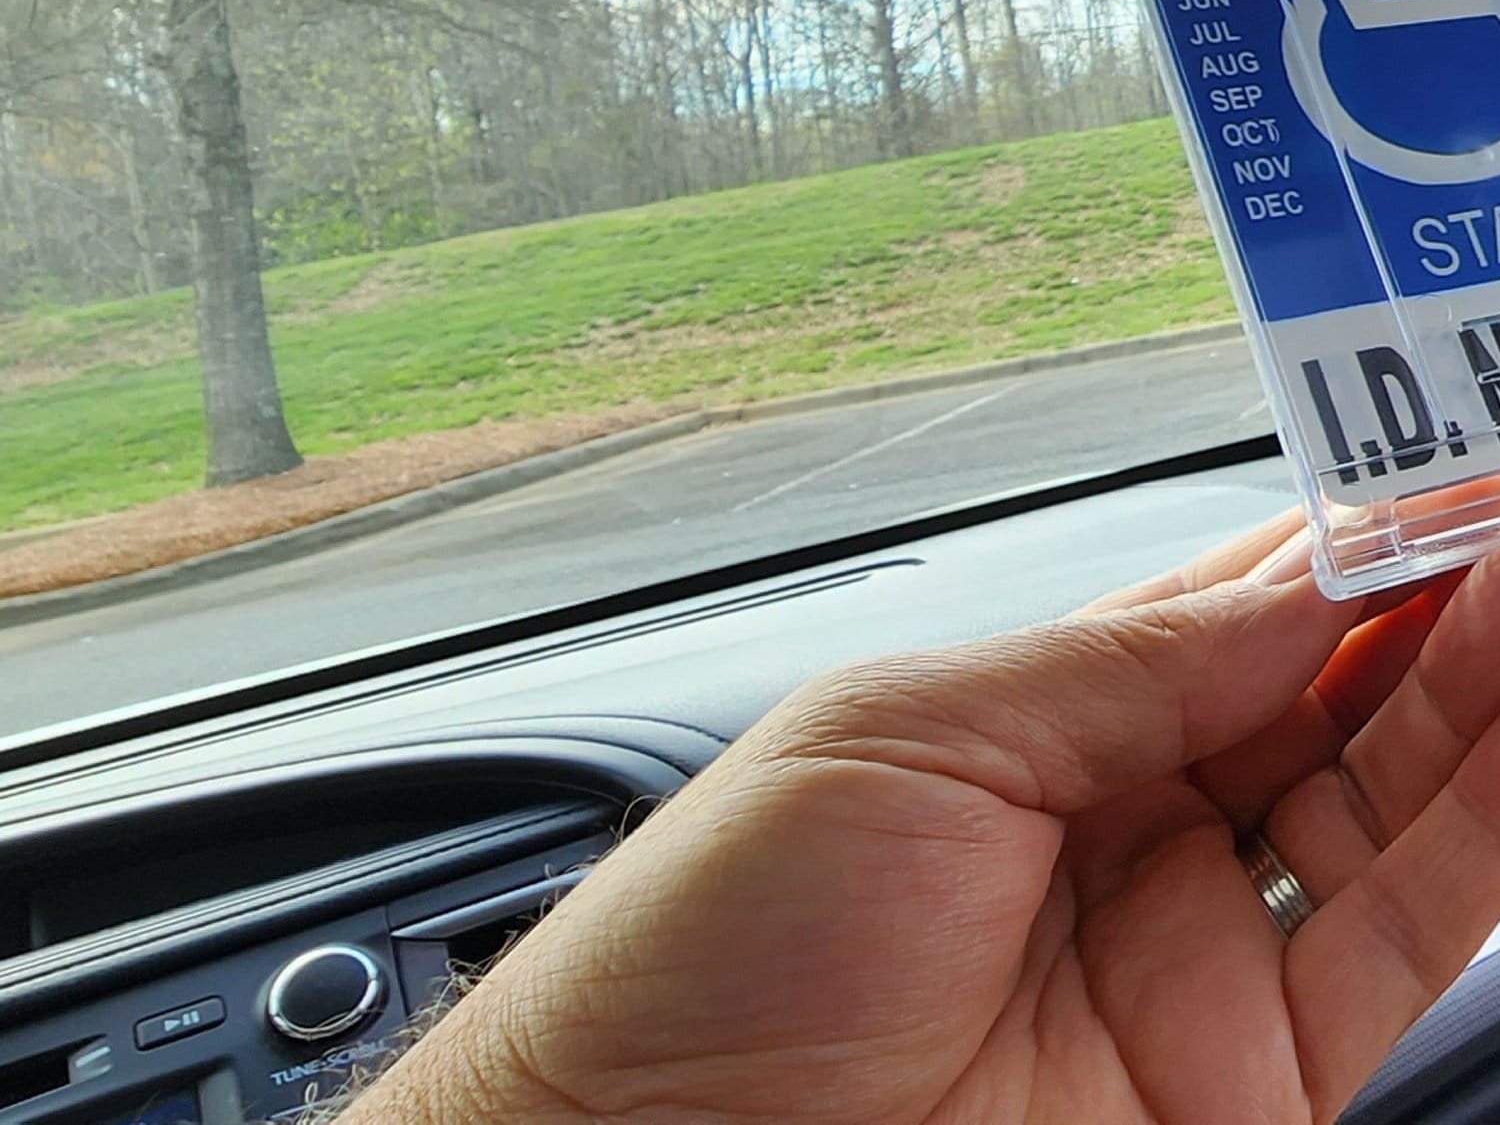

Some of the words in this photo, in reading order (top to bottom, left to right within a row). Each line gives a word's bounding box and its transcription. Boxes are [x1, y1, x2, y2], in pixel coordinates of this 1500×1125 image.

[1190, 22, 1241, 45] JUL
[1202, 52, 1260, 78] AUG
[1210, 86, 1262, 112] SEP
[1222, 119, 1277, 147] OCT
[1233, 155, 1290, 184] NOV
[1245, 191, 1303, 220] DEC
[1301, 345, 1469, 486] I.D.
